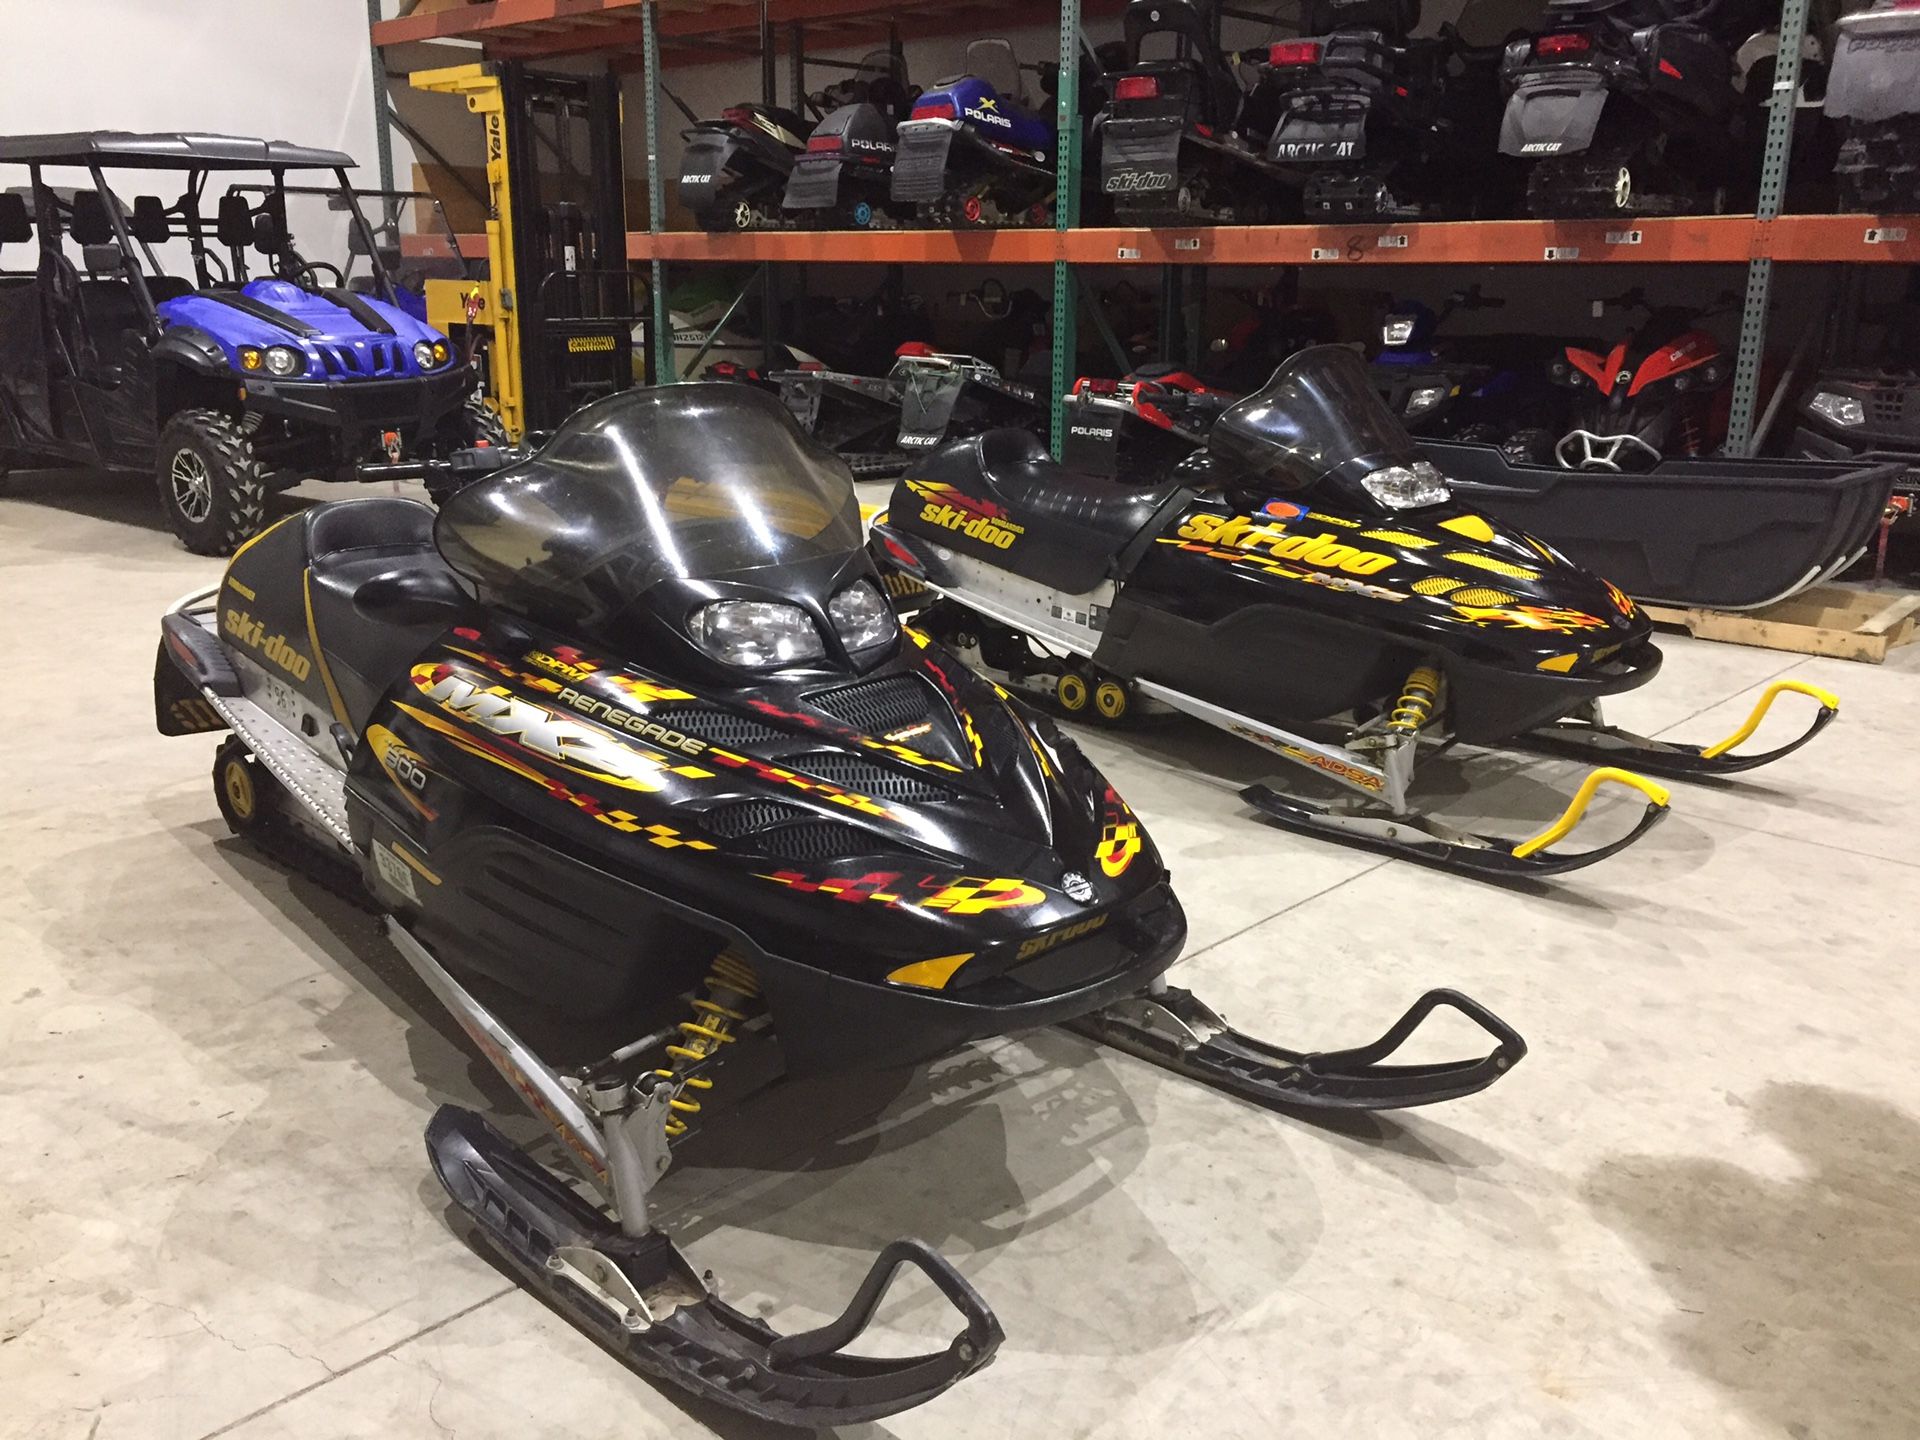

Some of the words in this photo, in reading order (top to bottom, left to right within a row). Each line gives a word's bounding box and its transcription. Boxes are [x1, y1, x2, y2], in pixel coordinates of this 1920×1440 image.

[964, 107, 1011, 127] POLARIS
[491, 115, 500, 162] Yale
[1521, 143, 1547, 152] ARCTIC
[1547, 142, 1562, 151] CAT
[1106, 171, 1172, 192] ski-doo
[459, 292, 485, 310] Ye
[570, 340, 606, 348] CAUTION
[900, 435, 924, 446] ARCTIC
[1070, 425, 1113, 437] POLARIS
[919, 503, 1016, 549] ski-doo
[1177, 513, 1397, 575] ski-doo
[224, 608, 311, 682] ski-doo
[536, 655, 591, 681] DPM
[558, 687, 707, 754] RENEGADE
[383, 745, 427, 790] 800
[1309, 755, 1385, 792] ADSA
